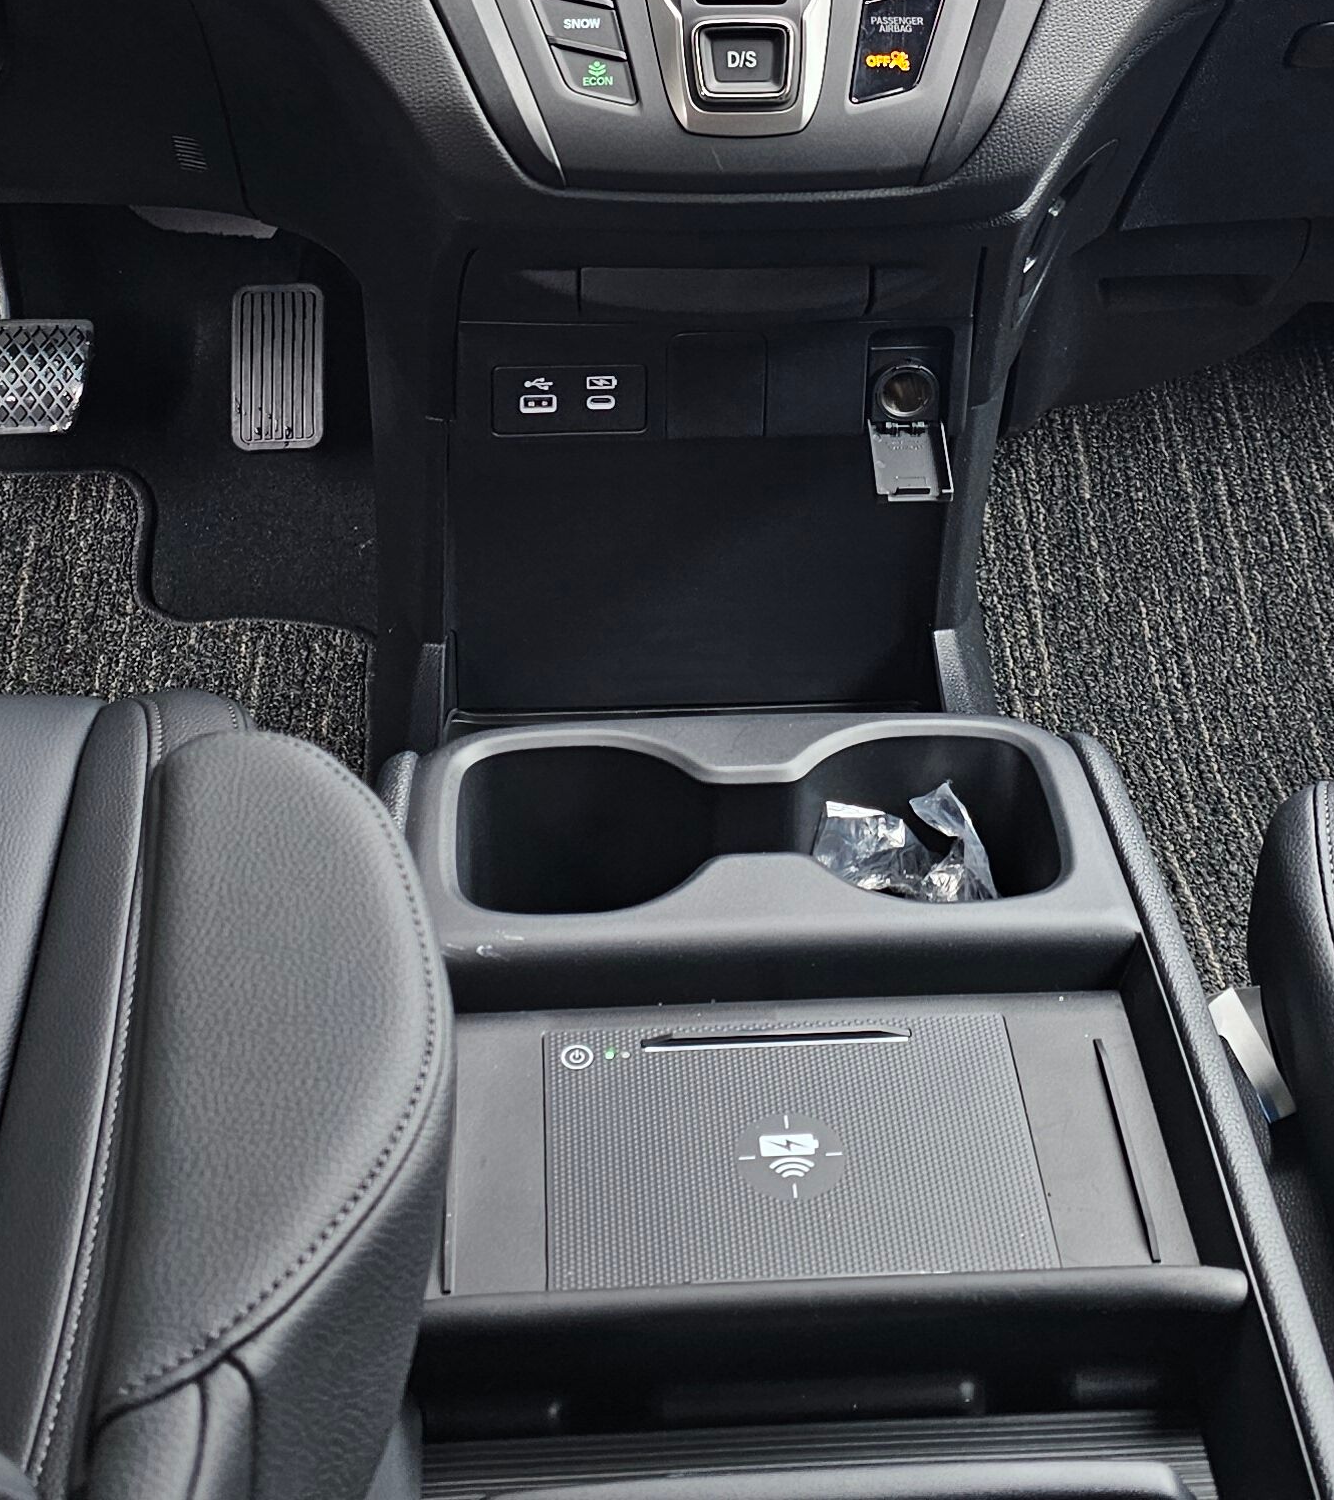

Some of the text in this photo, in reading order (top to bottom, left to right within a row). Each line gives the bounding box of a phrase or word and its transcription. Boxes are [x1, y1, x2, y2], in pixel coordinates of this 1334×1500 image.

[563, 18, 601, 29] SNOW
[870, 16, 924, 26] PASSENGER
[878, 25, 913, 33] AIRBAG
[727, 50, 757, 68] D/S
[865, 54, 891, 68] OFF
[582, 76, 613, 87] ECON
